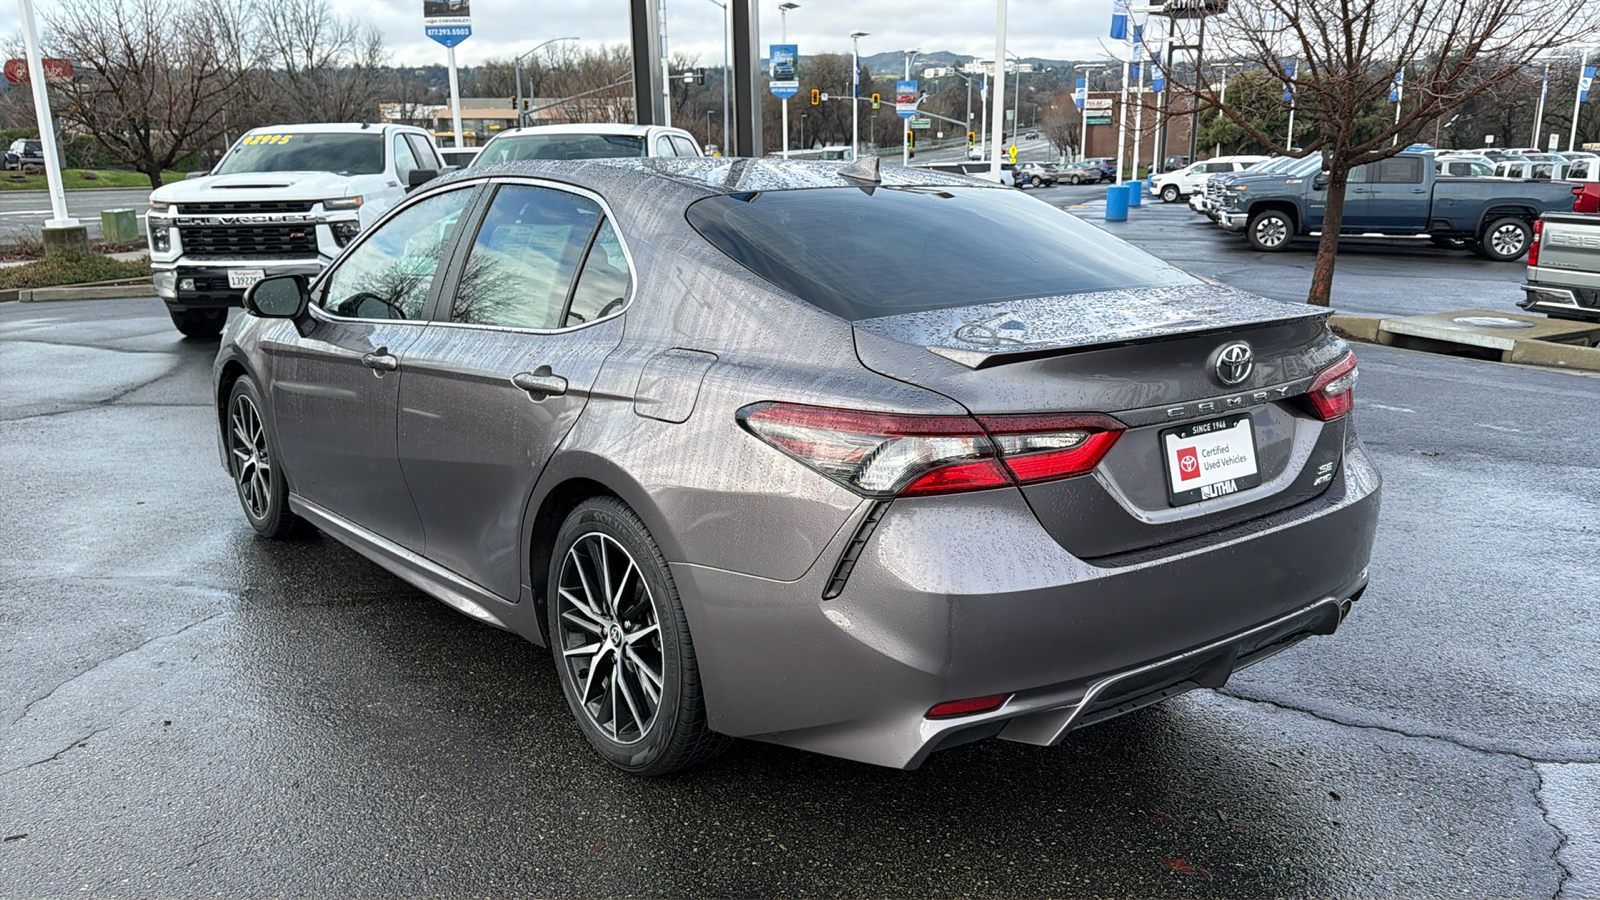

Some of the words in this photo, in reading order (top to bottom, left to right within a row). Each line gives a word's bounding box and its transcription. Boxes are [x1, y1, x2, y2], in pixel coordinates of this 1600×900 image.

[427, 28, 470, 36] 877.293.5503
[176, 214, 312, 225] CHEVROLET
[1167, 386, 1289, 417] CAMRY
[1192, 422, 1211, 435] SINCE
[1212, 420, 1227, 431] 1946
[1201, 444, 1230, 458] Certified
[1203, 458, 1221, 471] Used
[1220, 455, 1247, 468] Vehicles
[1317, 461, 1334, 475] SE
[1209, 479, 1238, 498] LITHIA
